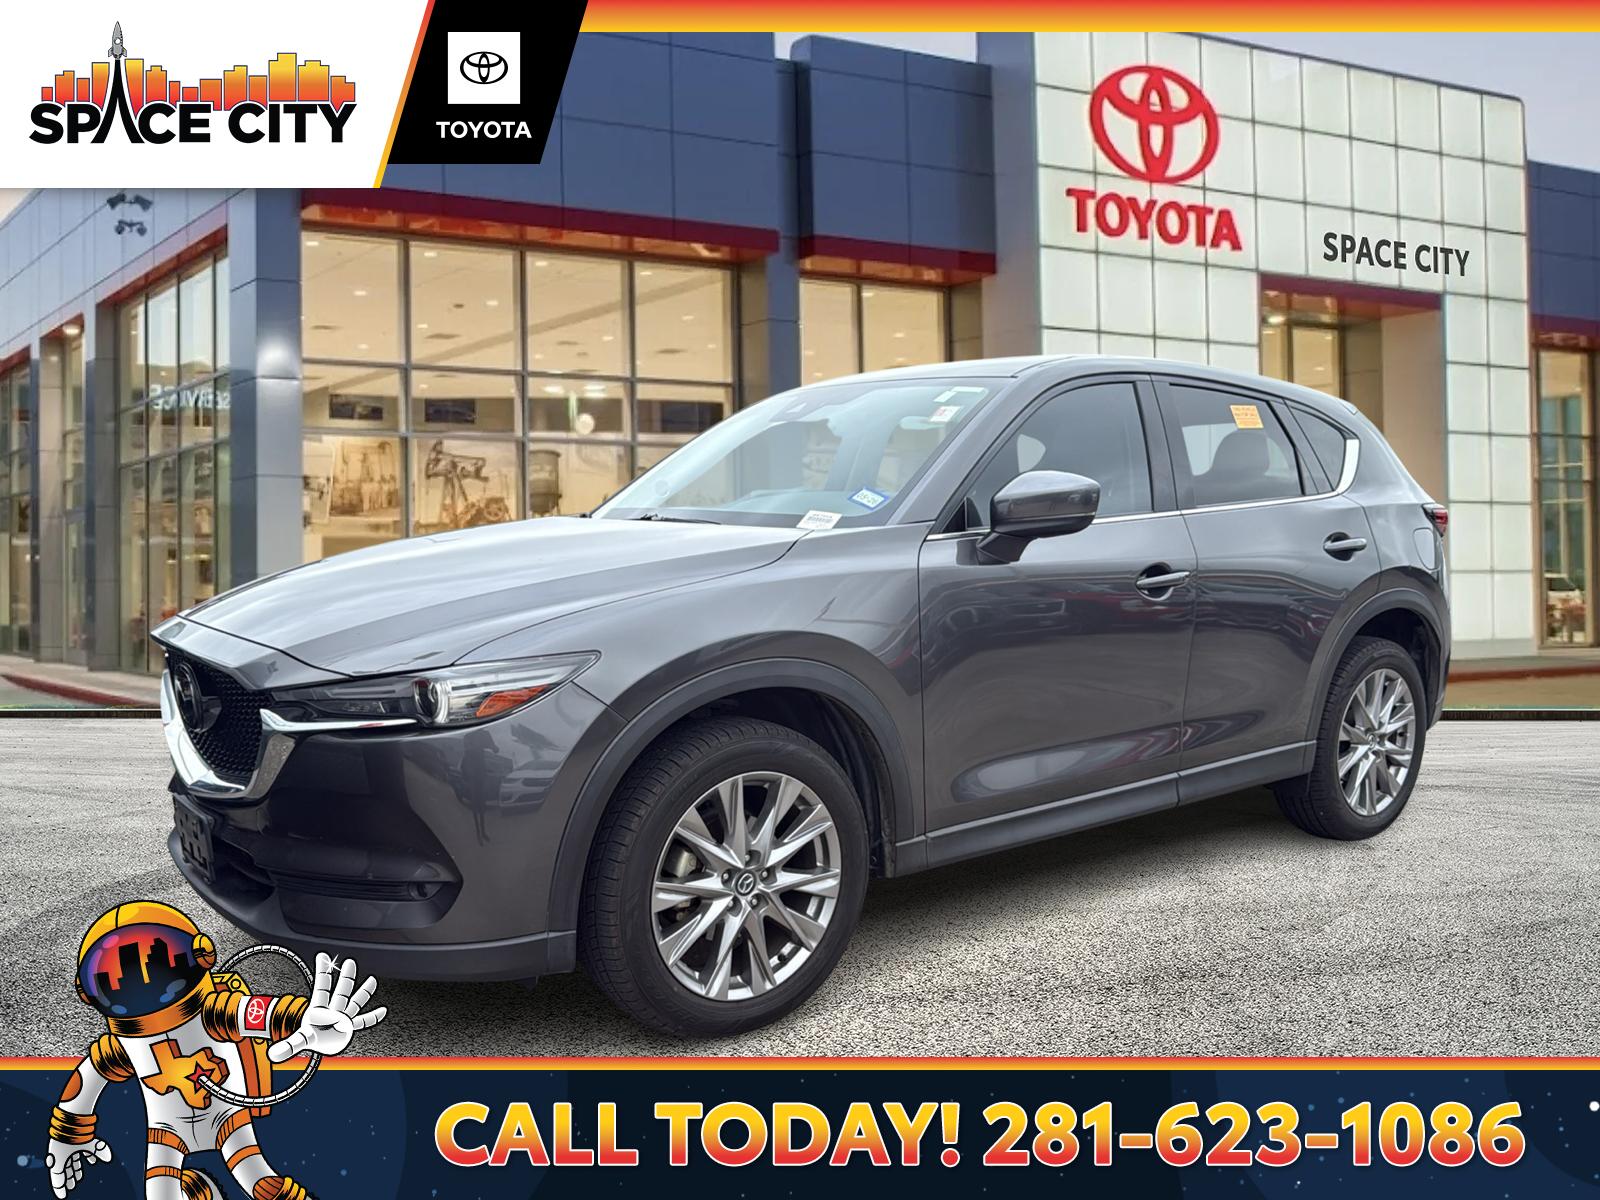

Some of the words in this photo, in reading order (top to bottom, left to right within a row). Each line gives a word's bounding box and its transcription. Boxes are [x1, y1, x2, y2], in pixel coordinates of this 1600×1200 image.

[1066, 186, 1243, 252] TOYOTA
[1322, 232, 1408, 270] SPACE
[1414, 244, 1471, 277] CITY
